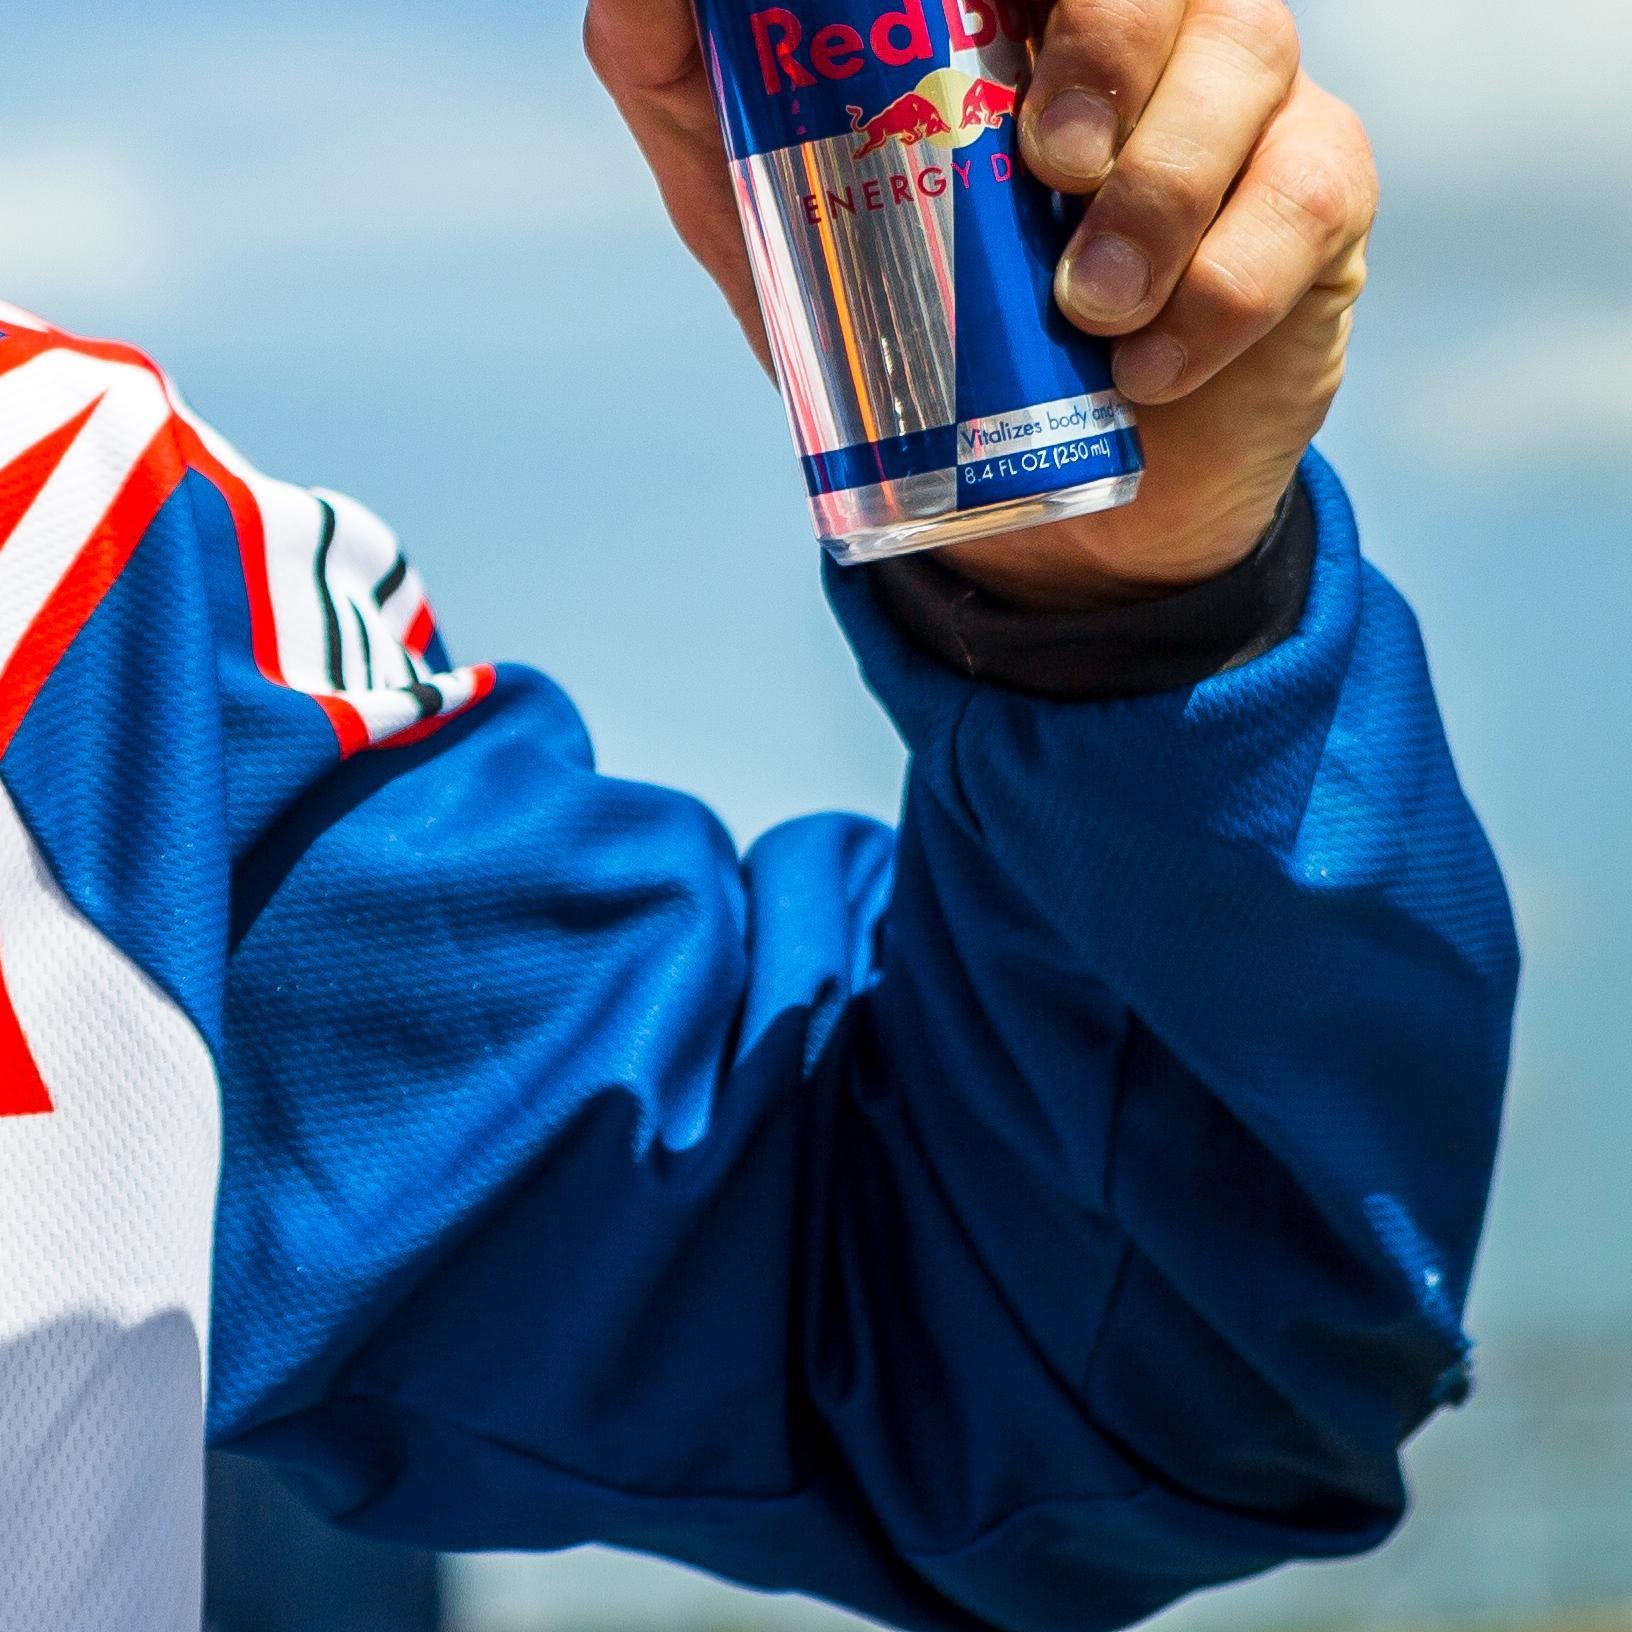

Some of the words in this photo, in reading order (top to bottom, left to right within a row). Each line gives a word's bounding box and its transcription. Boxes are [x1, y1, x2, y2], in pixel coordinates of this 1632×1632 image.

[802, 160, 971, 225] ENERGY
[960, 420, 1042, 449] Vitalizes
[1046, 405, 1087, 430] body
[1092, 399, 1115, 421] and
[964, 466, 994, 485] 8.4
[999, 459, 1018, 477] FL
[1021, 450, 1050, 471] OZ
[1053, 442, 1089, 469] (250
